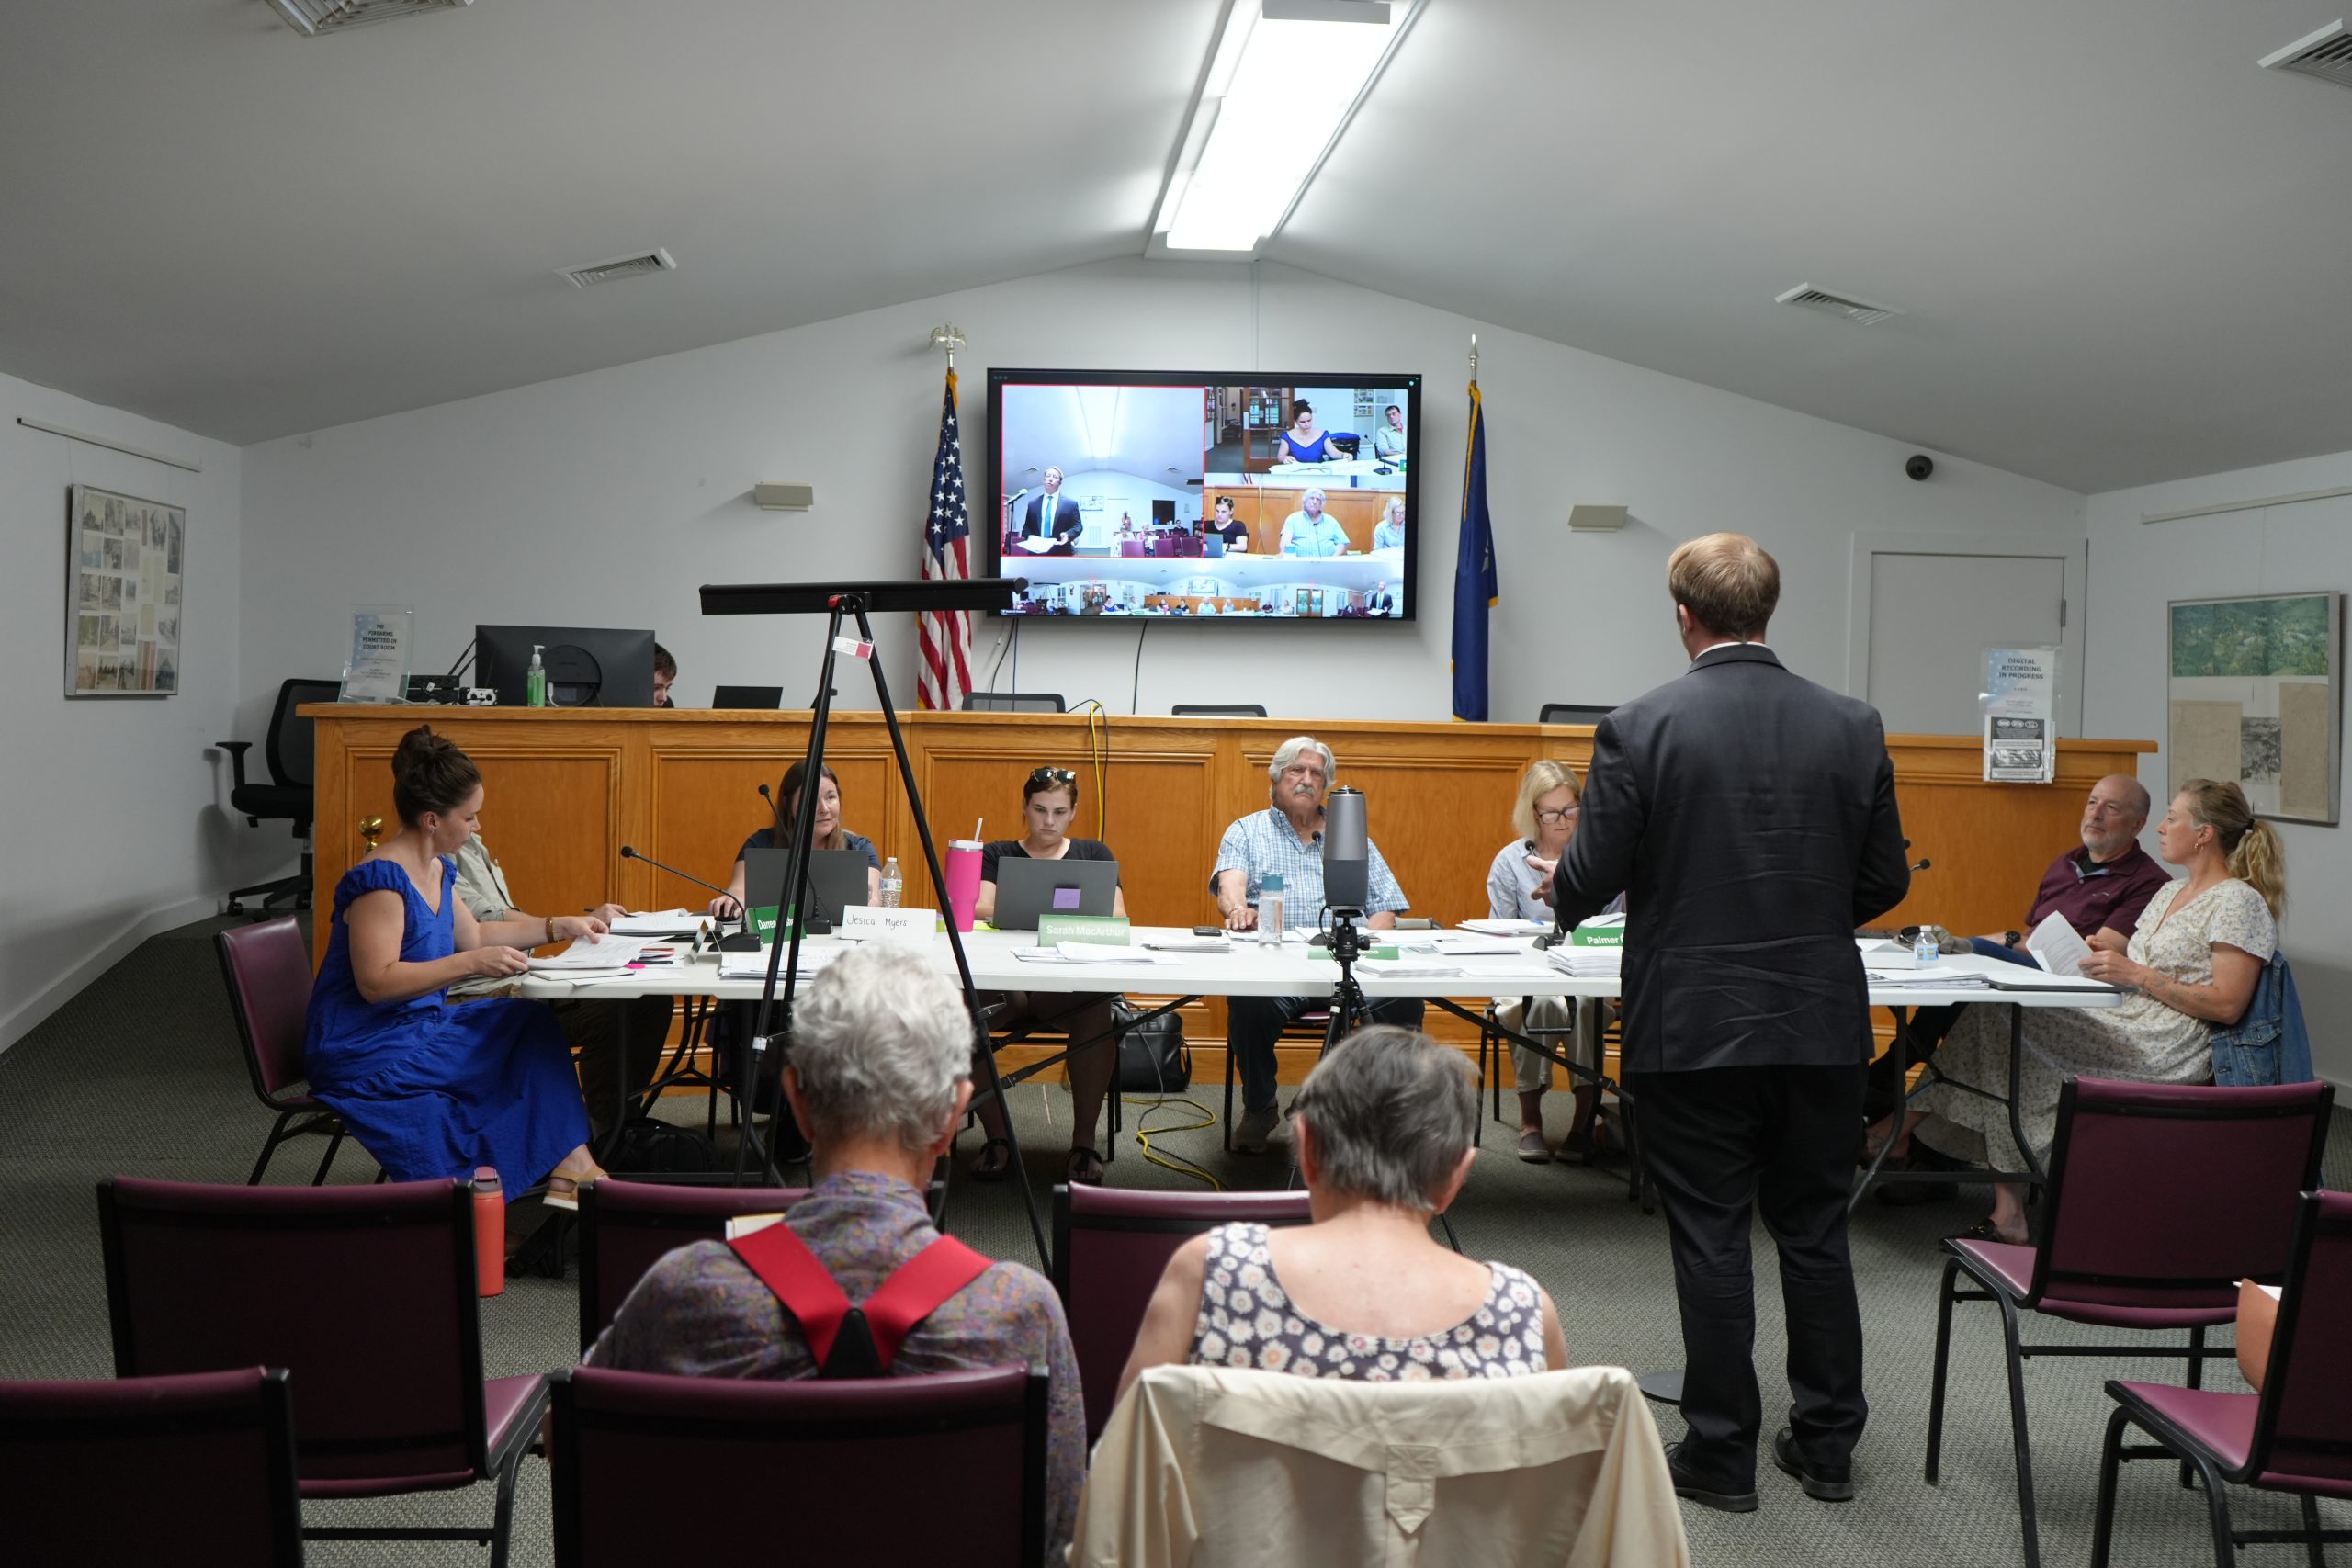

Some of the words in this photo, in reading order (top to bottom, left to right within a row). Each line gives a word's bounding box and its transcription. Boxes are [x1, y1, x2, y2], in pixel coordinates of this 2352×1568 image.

[885, 918, 908, 931] Myers
[1046, 925, 1074, 935] Sarah
[1076, 926, 1125, 937] MacArthur
[1586, 936, 1619, 944] Palmer
